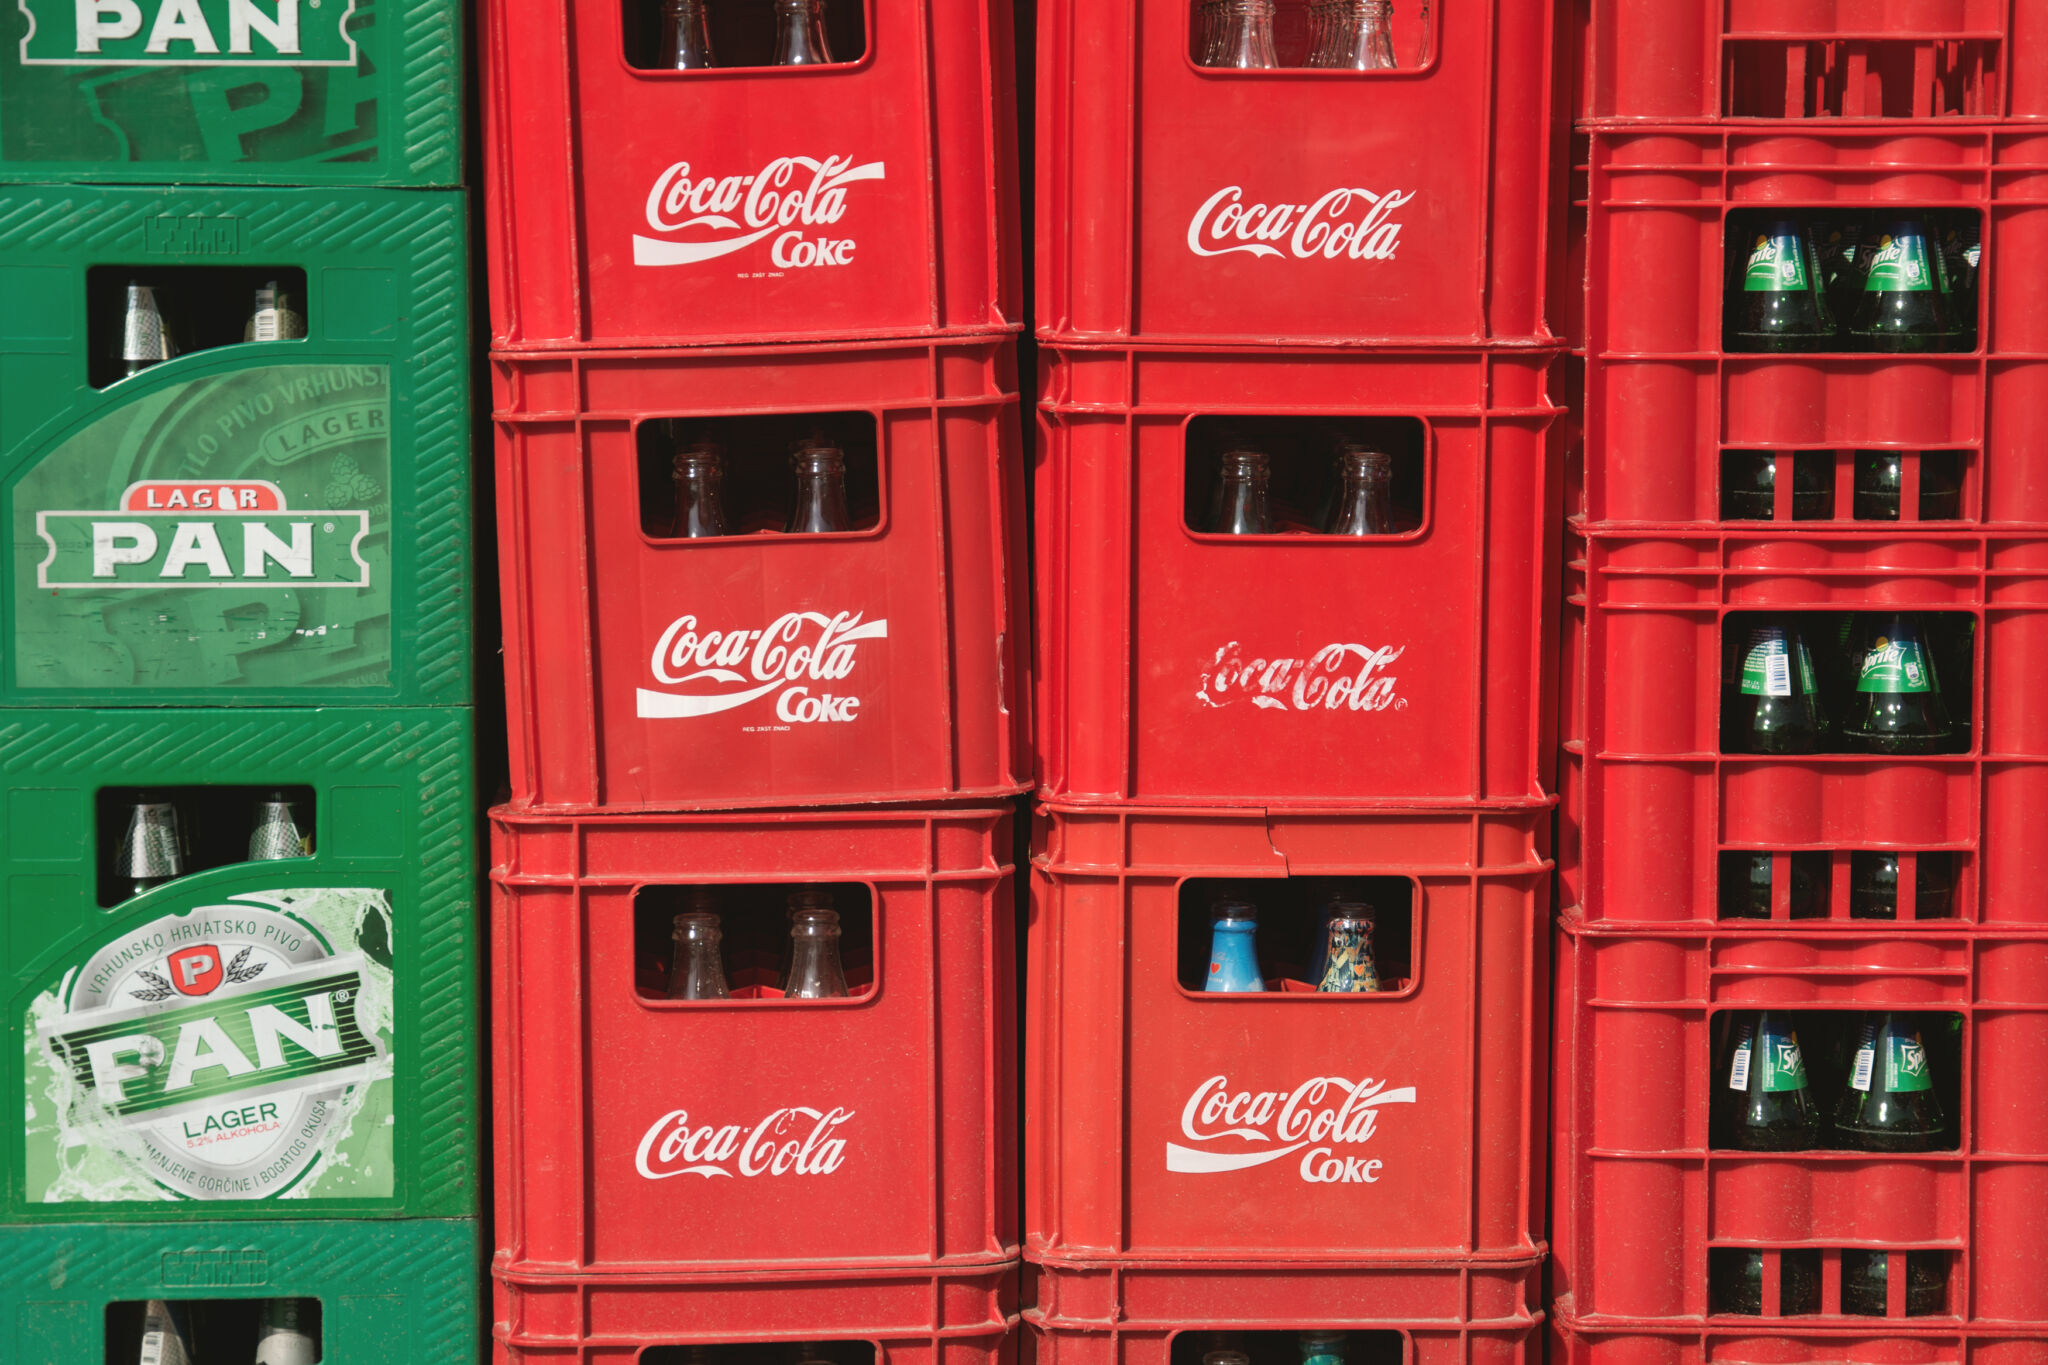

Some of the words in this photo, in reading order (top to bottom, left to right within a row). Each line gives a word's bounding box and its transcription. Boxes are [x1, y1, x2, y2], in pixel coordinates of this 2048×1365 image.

[75, 0, 302, 54] PAN
[646, 154, 853, 232] Coca-Cola
[771, 231, 856, 268] Coke
[1187, 185, 1417, 260] Coca-Cola
[216, 393, 274, 438] PIVO
[278, 408, 385, 453] LAGER
[146, 487, 259, 510] LAGR
[91, 522, 314, 578] PAN
[651, 611, 863, 684] Coca-Cola
[776, 686, 860, 722] Coke
[87, 933, 165, 995] VRHUNSKO
[170, 920, 257, 943] HRVATSKO
[263, 924, 301, 952] PIVO
[178, 954, 214, 987] P
[82, 991, 349, 1102] PAN
[183, 1102, 279, 1139] LAGER
[215, 1121, 281, 1143] ALKOHOLA
[1181, 1075, 1387, 1143] Coca-Cola
[259, 1138, 307, 1184] BOGATOG
[300, 1099, 327, 1139] OKUSA
[634, 1106, 856, 1180] Coca-Cola
[1300, 1147, 1383, 1183] Coke
